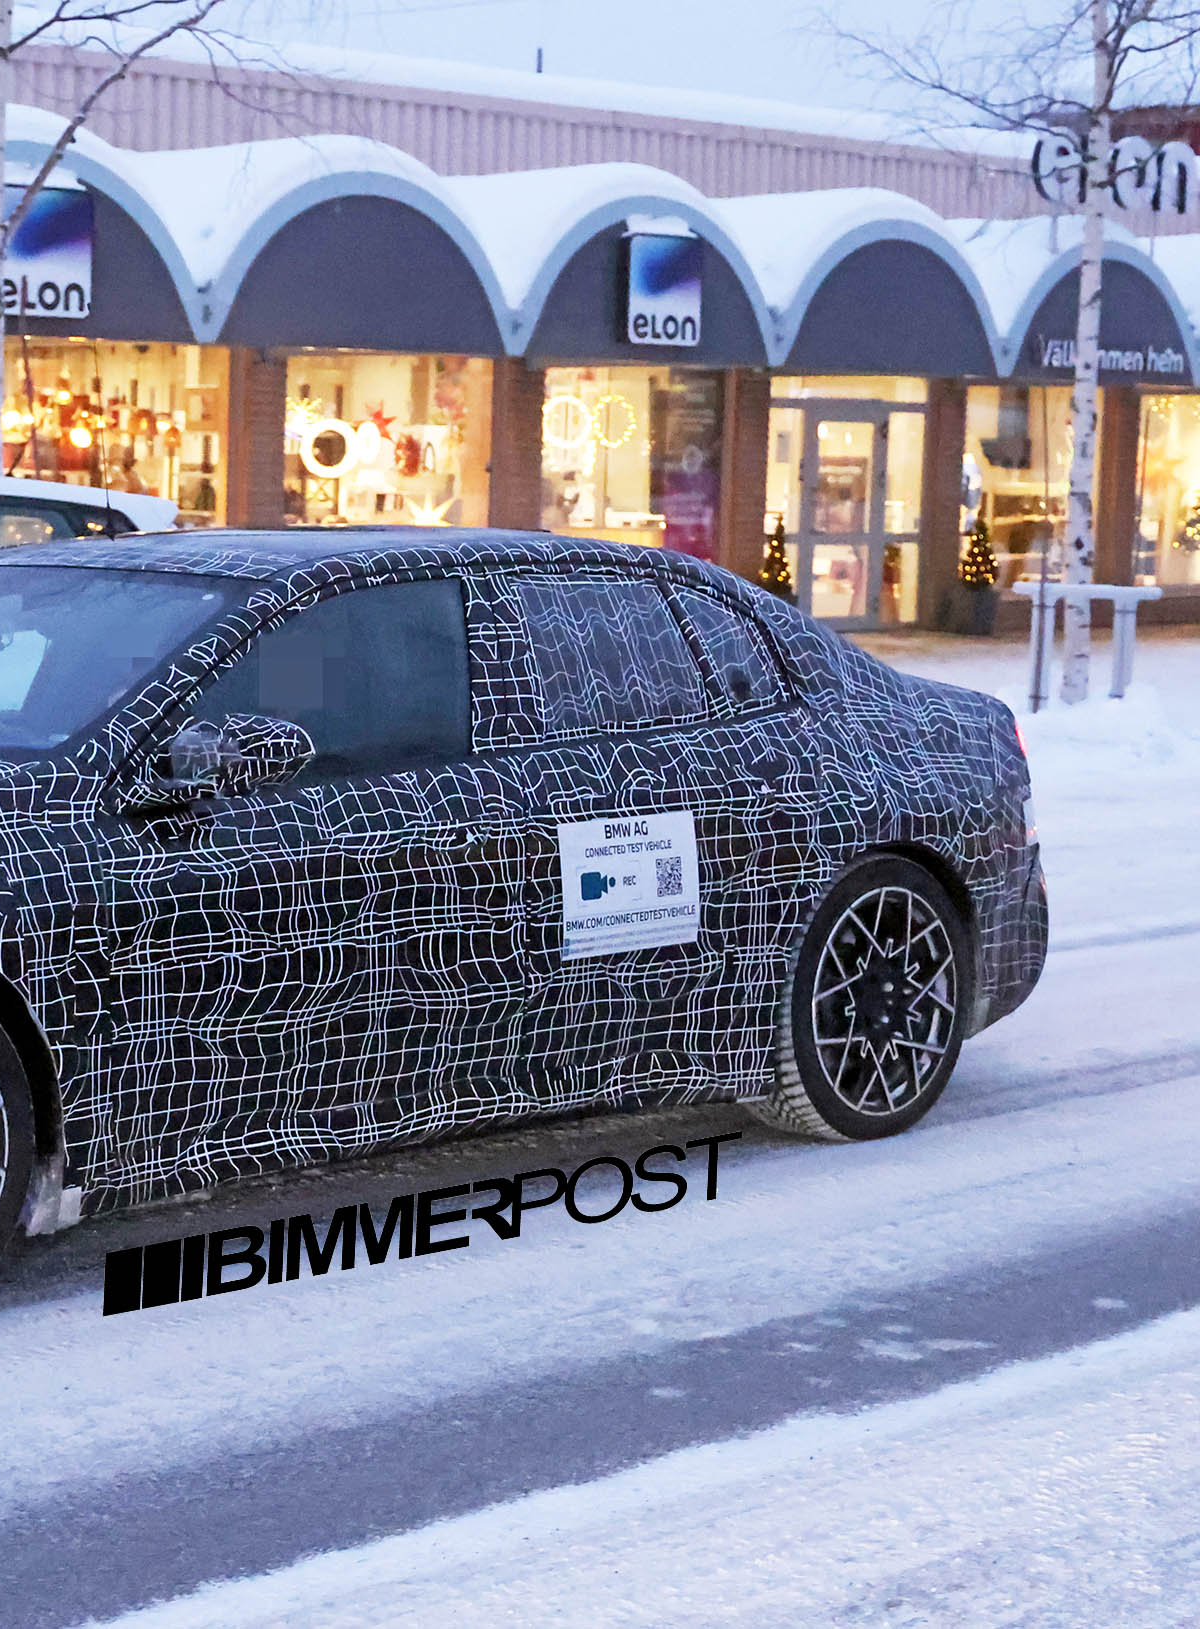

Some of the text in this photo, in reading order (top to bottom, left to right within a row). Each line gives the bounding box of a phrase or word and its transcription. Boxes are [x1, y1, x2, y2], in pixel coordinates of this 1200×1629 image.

[604, 820, 649, 840] BMW AG
[585, 839, 672, 859] CONNECTED TEST VEHICLE
[622, 875, 637, 886] REC
[565, 904, 697, 932] BMW.COM/CONNECTEDTESTVEHICLE
